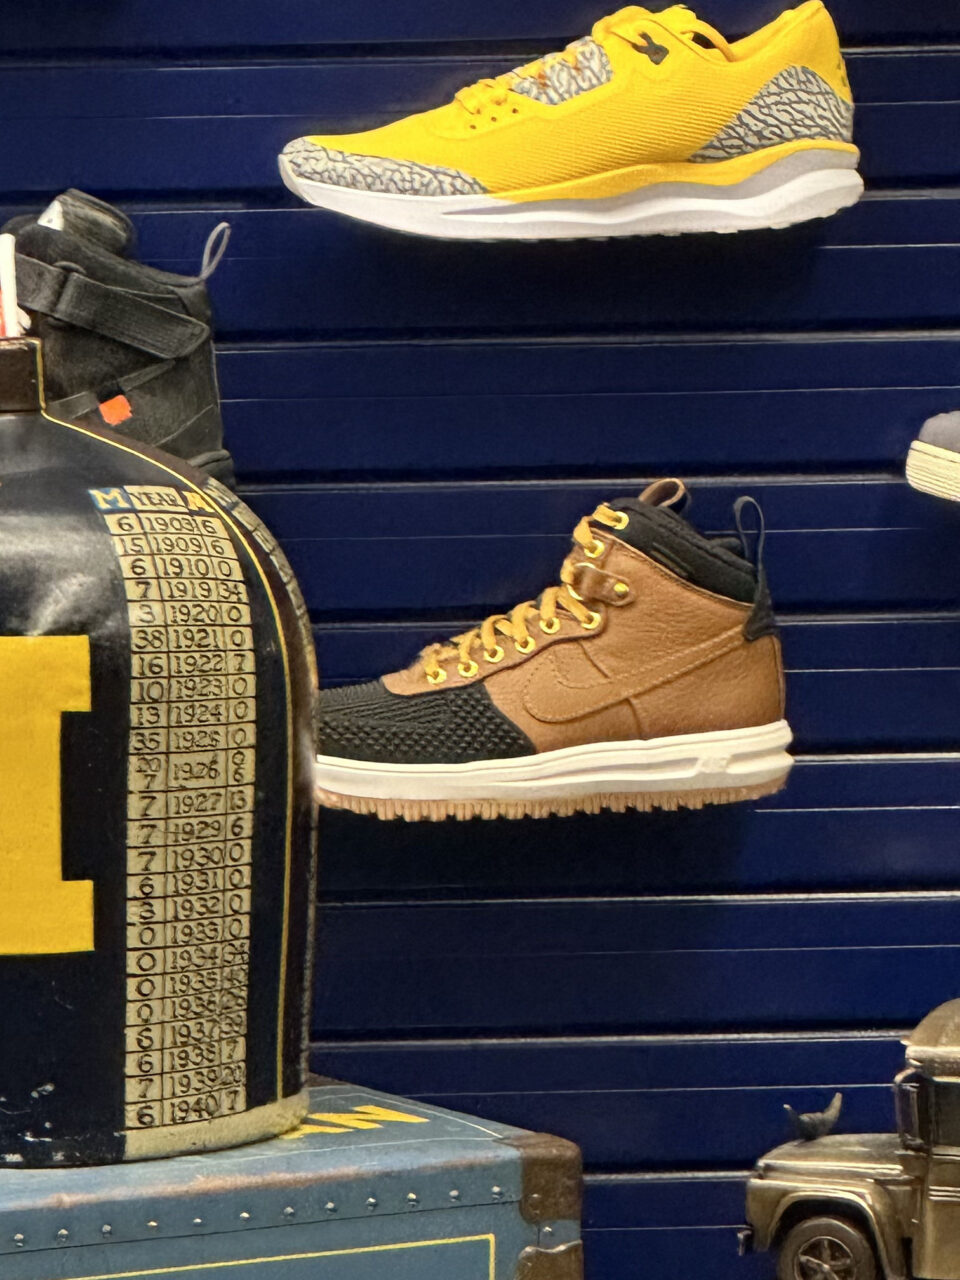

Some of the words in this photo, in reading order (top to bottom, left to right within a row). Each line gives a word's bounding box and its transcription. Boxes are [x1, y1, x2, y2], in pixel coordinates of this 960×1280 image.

[89, 488, 132, 509] M
[118, 516, 134, 532] 6
[145, 516, 195, 533] 1903
[202, 519, 217, 534] 6
[121, 537, 144, 554] 15
[153, 537, 202, 554] 1909
[210, 540, 225, 556] 6
[131, 558, 147, 576] 6
[160, 557, 210, 577] 1910
[218, 560, 232, 577] 0
[136, 581, 153, 599] 7
[166, 581, 212, 600] 1919
[139, 604, 156, 624] 3
[170, 604, 220, 625] 1920
[227, 605, 243, 623] 0
[134, 629, 165, 650] 38
[173, 629, 221, 650] 1921
[230, 629, 247, 648] 0
[138, 656, 164, 677] 16
[174, 654, 224, 675] 1922
[138, 681, 164, 702] 10
[176, 678, 224, 700] 1923
[232, 677, 248, 697] 0
[135, 706, 161, 726] 13
[172, 704, 223, 725] 1924
[233, 701, 249, 720] 0
[133, 732, 162, 751] 35
[231, 727, 247, 746] 0
[139, 795, 158, 818] 7
[173, 791, 223, 816] 1927
[138, 823, 158, 845] 7
[172, 820, 222, 844] 1929
[231, 817, 245, 837] 6
[137, 850, 157, 872] 7
[172, 846, 224, 871] 1930
[229, 843, 245, 863] 0
[139, 876, 155, 896] 6
[172, 871, 220, 894] 1931
[229, 868, 245, 889] 0
[173, 896, 221, 921] 1932
[230, 893, 244, 914] 0
[139, 926, 156, 946] 0
[172, 921, 220, 945] 1933
[229, 918, 244, 939] 0
[136, 952, 158, 972] 0
[136, 978, 156, 997] 0
[170, 970, 218, 995] 1935
[137, 1003, 154, 1023] 0
[138, 1053, 154, 1074] 6
[138, 1078, 155, 1099] 7
[137, 1104, 155, 1127] 6
[170, 1094, 219, 1125] 1940
[226, 1090, 240, 1111] 7
